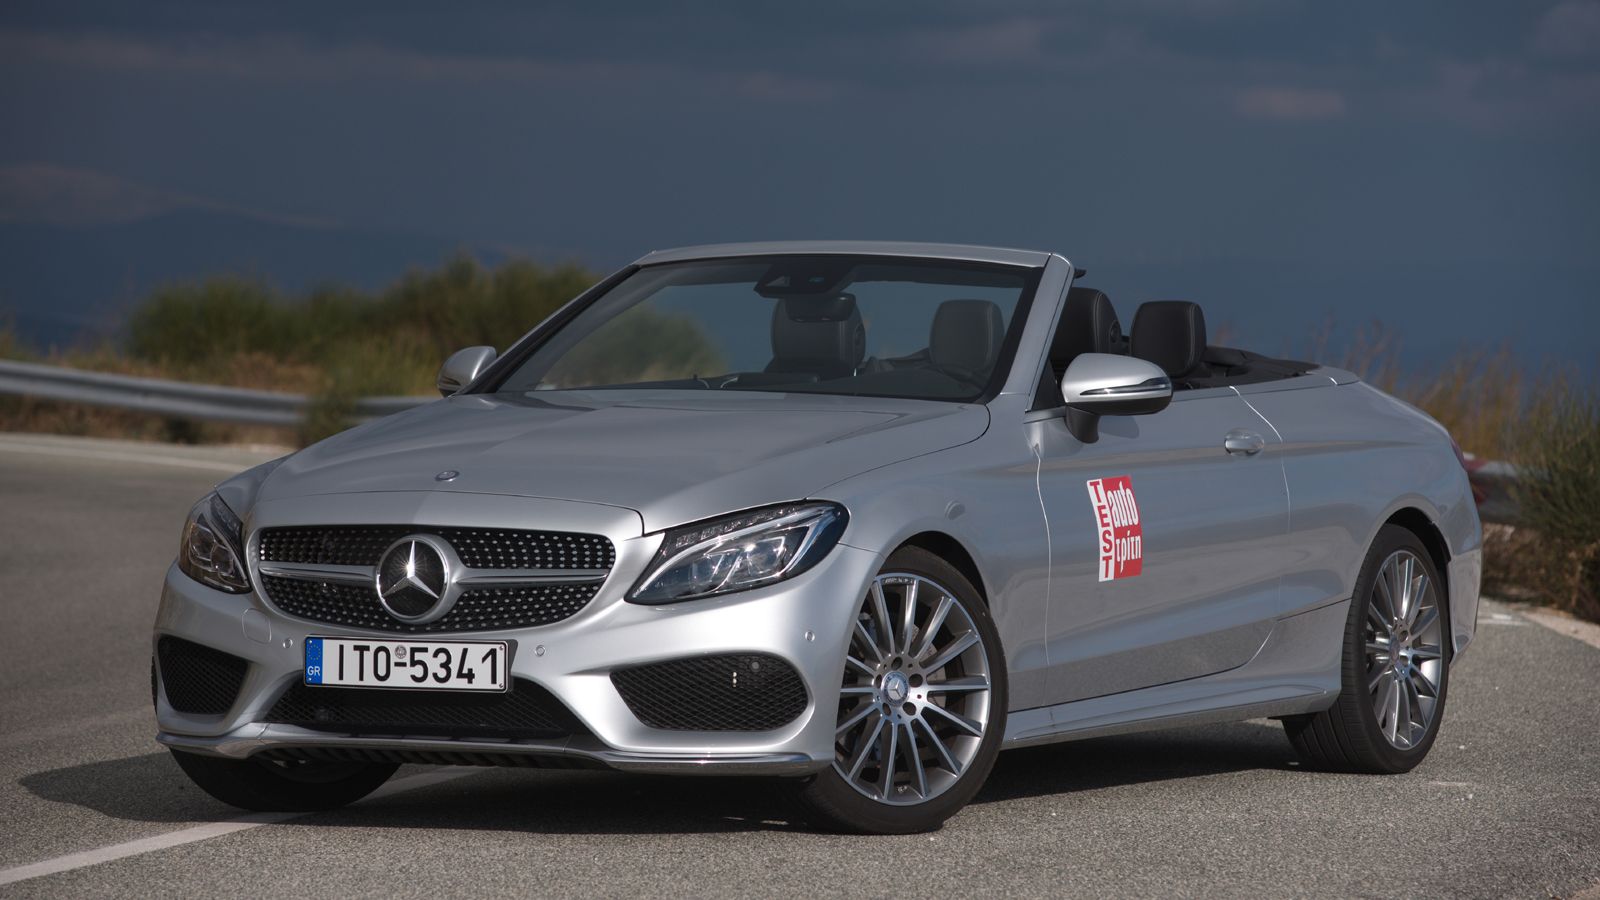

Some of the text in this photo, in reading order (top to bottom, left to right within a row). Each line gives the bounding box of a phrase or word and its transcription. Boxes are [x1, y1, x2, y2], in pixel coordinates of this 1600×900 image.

[1107, 481, 1139, 528] auto
[1090, 481, 1112, 578] TEST
[307, 666, 321, 676] GR
[338, 644, 498, 685] ITO-5341
